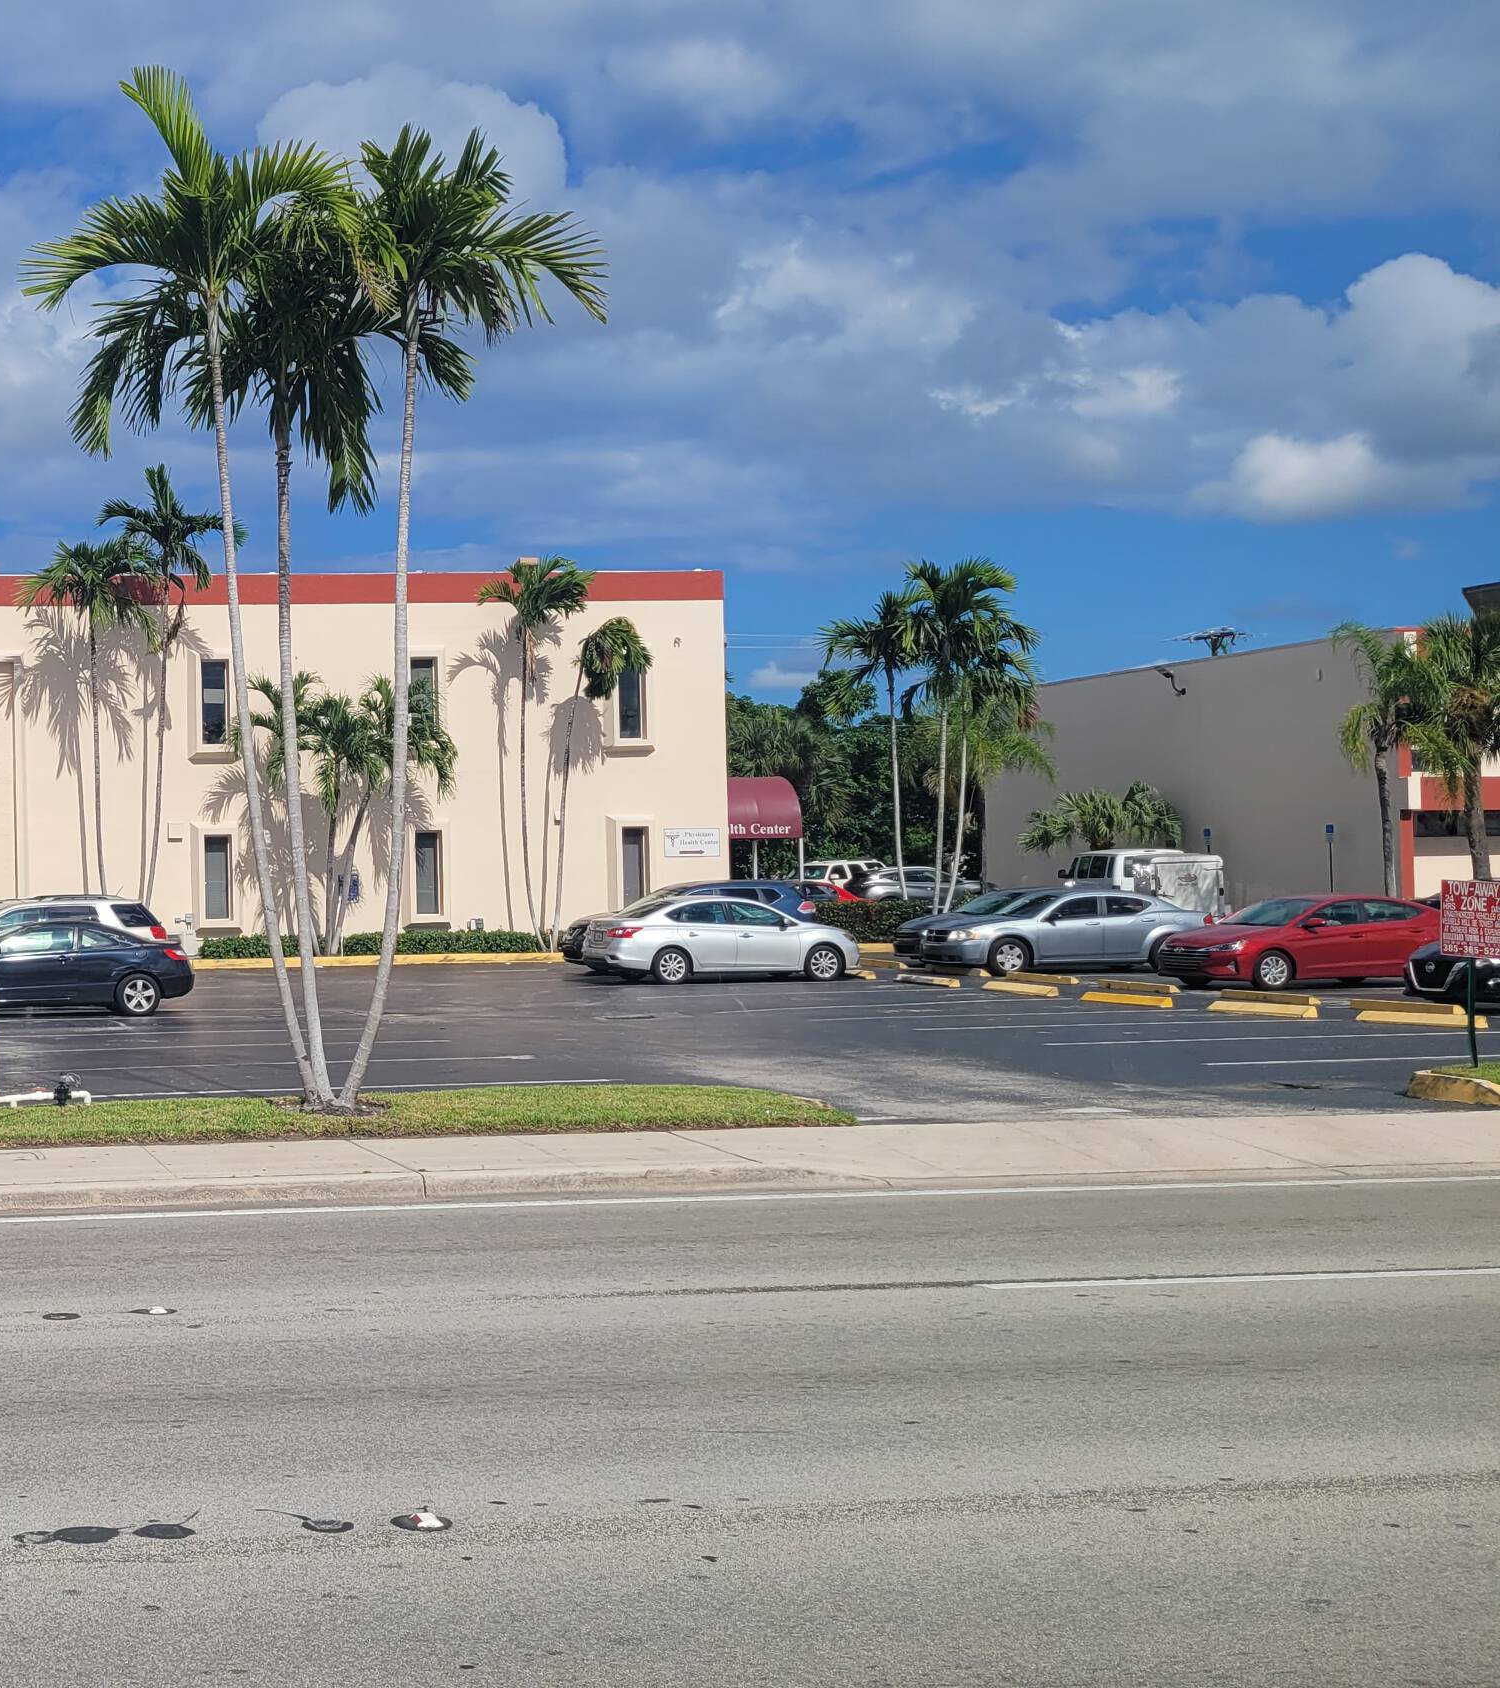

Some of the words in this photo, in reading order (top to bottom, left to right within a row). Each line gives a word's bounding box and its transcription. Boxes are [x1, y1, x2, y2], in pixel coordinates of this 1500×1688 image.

[728, 823, 746, 835] lth
[750, 823, 792, 835] Center
[1447, 881, 1499, 897] TOW-AWAY
[1460, 896, 1487, 911] ZONE
